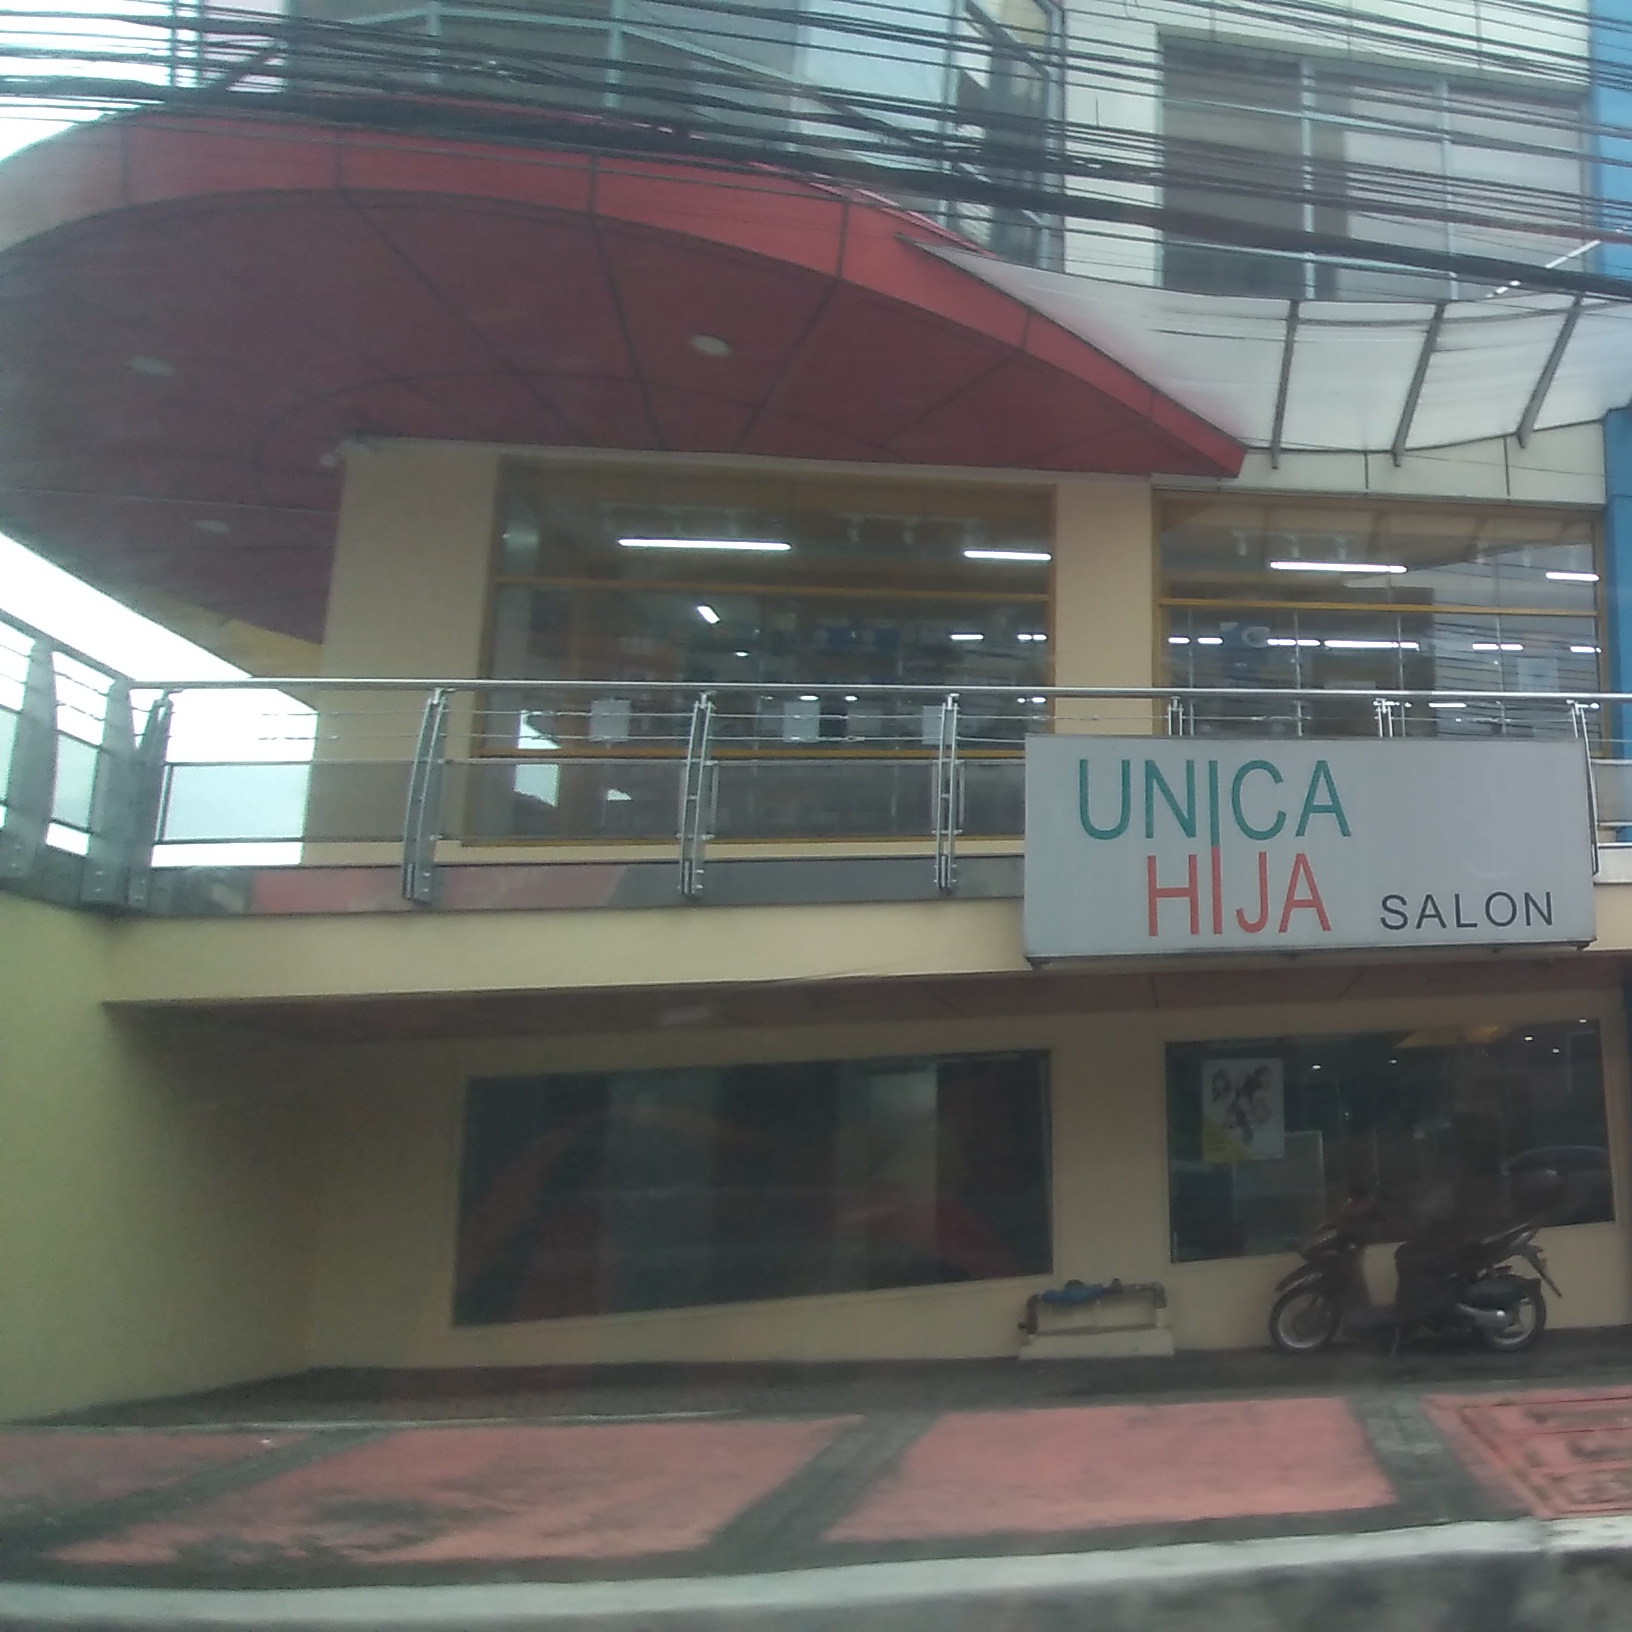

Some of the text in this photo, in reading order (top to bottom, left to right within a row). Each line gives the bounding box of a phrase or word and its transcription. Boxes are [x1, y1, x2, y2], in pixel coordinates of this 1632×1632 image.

[1079, 760, 1351, 845] UNICA
[1147, 846, 1553, 936] HIJA SALON
